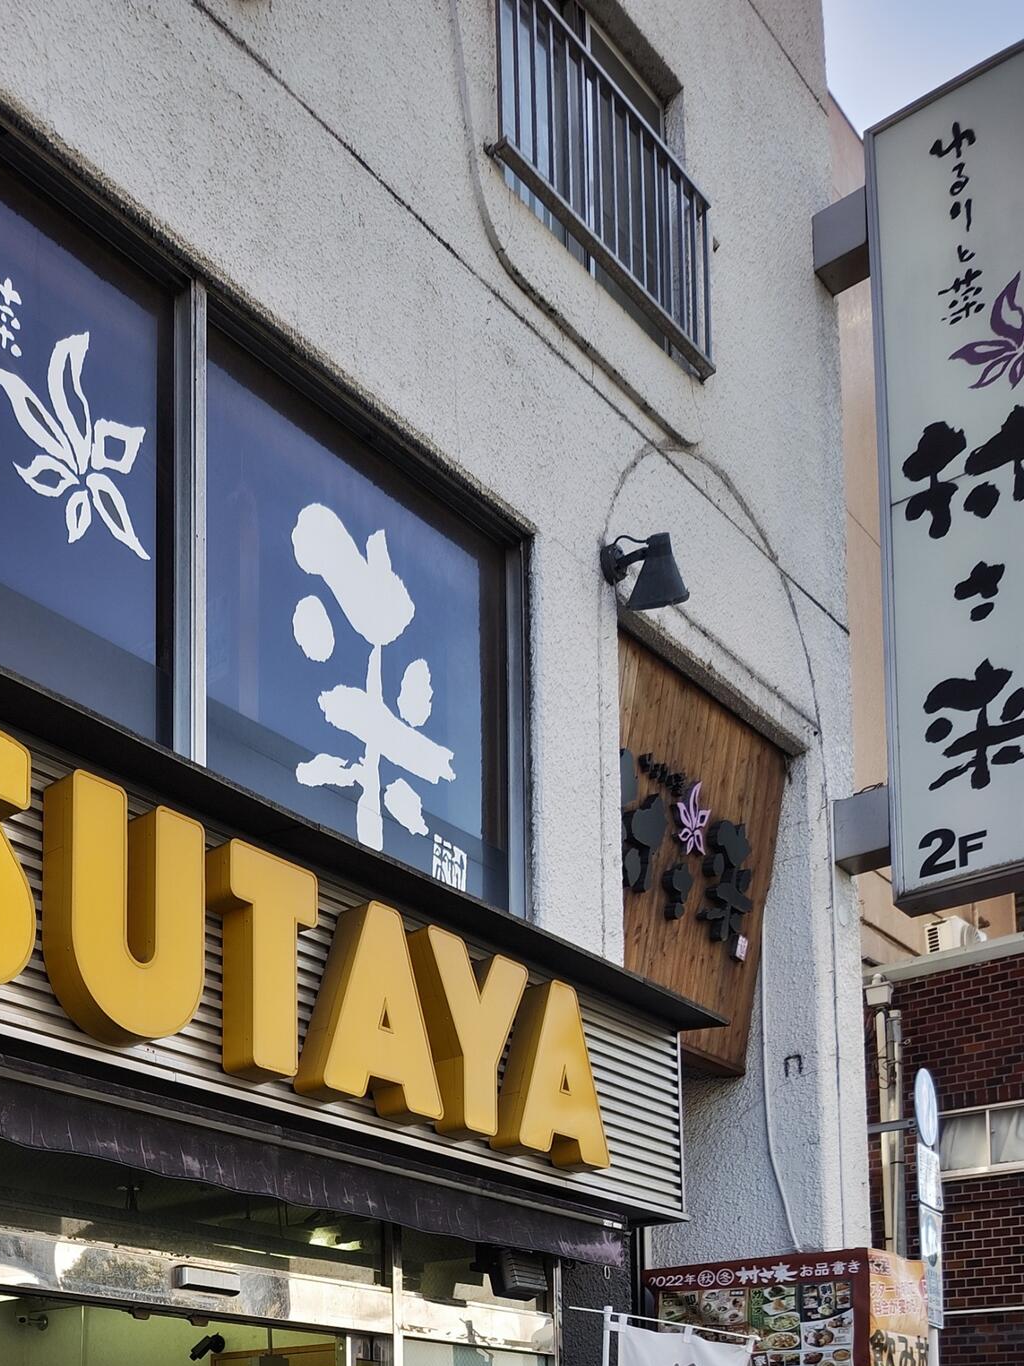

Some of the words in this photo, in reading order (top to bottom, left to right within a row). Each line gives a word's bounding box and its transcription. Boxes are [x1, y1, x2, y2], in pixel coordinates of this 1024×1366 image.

[918, 827, 988, 879] 2F
[648, 1273, 696, 1288] 2022年
[735, 1261, 798, 1285] 村さ来
[799, 1259, 861, 1277] お品書き
